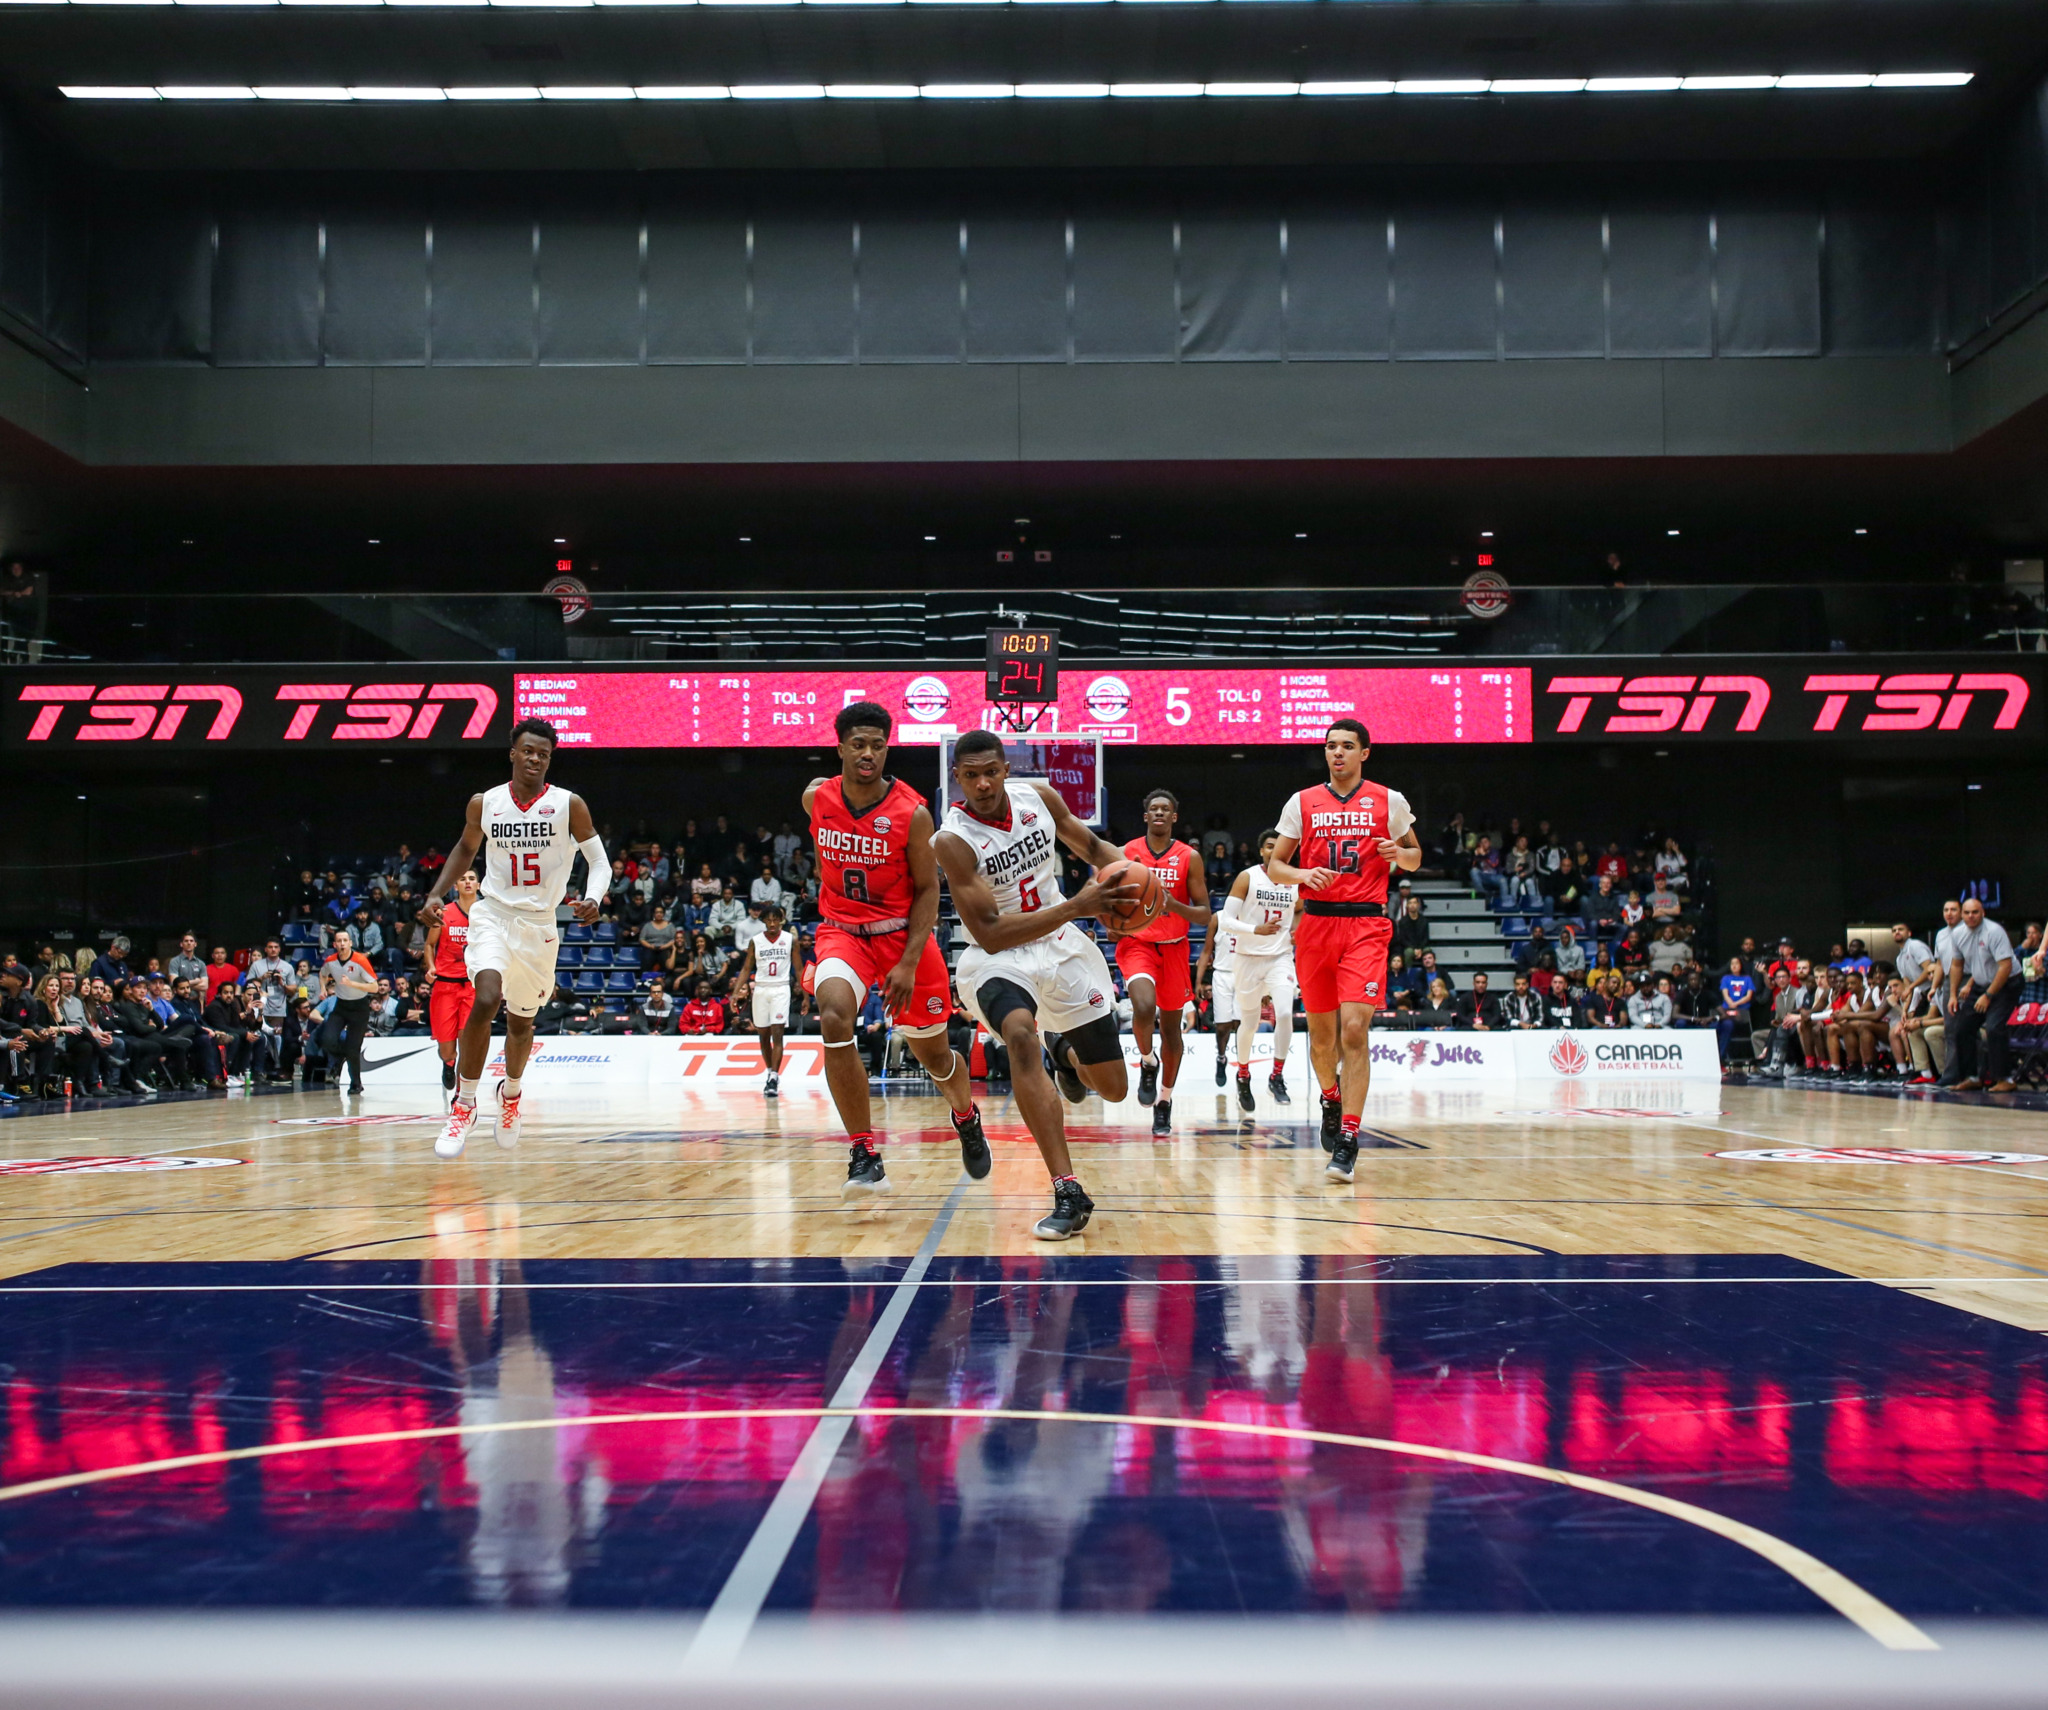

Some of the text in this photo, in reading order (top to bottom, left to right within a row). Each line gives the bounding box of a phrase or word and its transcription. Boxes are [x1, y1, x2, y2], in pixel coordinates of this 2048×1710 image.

[558, 560, 572, 570] EXIT
[1478, 554, 1492, 565] EXIT
[1002, 634, 1048, 652] 10:07
[519, 680, 530, 690] 30
[533, 680, 577, 690] BEDIAKO
[670, 680, 688, 689] FLS
[720, 679, 739, 688] PTS
[743, 679, 750, 688] 0
[1001, 660, 1043, 694] 24
[1289, 676, 1327, 685] MOORE
[1431, 675, 1450, 684] FLS
[1482, 674, 1501, 684] PTS
[1504, 674, 1512, 684] 0
[519, 692, 750, 703] 0 BROWN 0 0
[1455, 688, 1462, 697] 0
[1505, 688, 1512, 697] 2
[1166, 687, 1192, 726] 5
[1281, 702, 1512, 712] 15 PATTERSON 0 3
[1546, 676, 1771, 732] TSN
[1803, 674, 2030, 732] TSN
[18, 685, 243, 740] TSN
[275, 684, 498, 740] TSN
[520, 706, 750, 716] 12 HEMMINGS 0 3
[743, 719, 750, 728] 2
[1281, 715, 1512, 725] 24 SAMUEL 0 0
[556, 732, 750, 742] RIEFFE 0 0
[1281, 729, 1292, 738] 33
[1455, 729, 1462, 738] 0
[1506, 728, 1512, 737] 0
[1311, 812, 1376, 828] BIOSTEEL
[492, 822, 556, 838] BIOSTEEL
[1316, 828, 1370, 837] ALL CANADIAN
[818, 828, 892, 856] BIOSTEEL
[822, 850, 885, 865] ALL CANADIAN
[985, 829, 1051, 876] BIOSTEEL
[1328, 840, 1359, 874] 15
[510, 853, 540, 886] 15
[994, 850, 1050, 886] ALL CANADIAN
[1148, 867, 1180, 880] TEEL
[843, 868, 870, 903] 8
[1019, 874, 1042, 912] 6
[1256, 890, 1293, 902] BIOSTEEL
[449, 926, 468, 936] BIOS
[760, 949, 788, 957] BIOSTEEL
[769, 962, 777, 976] 0
[678, 1042, 826, 1076] TSN
[1594, 1044, 1682, 1061] CANADA
